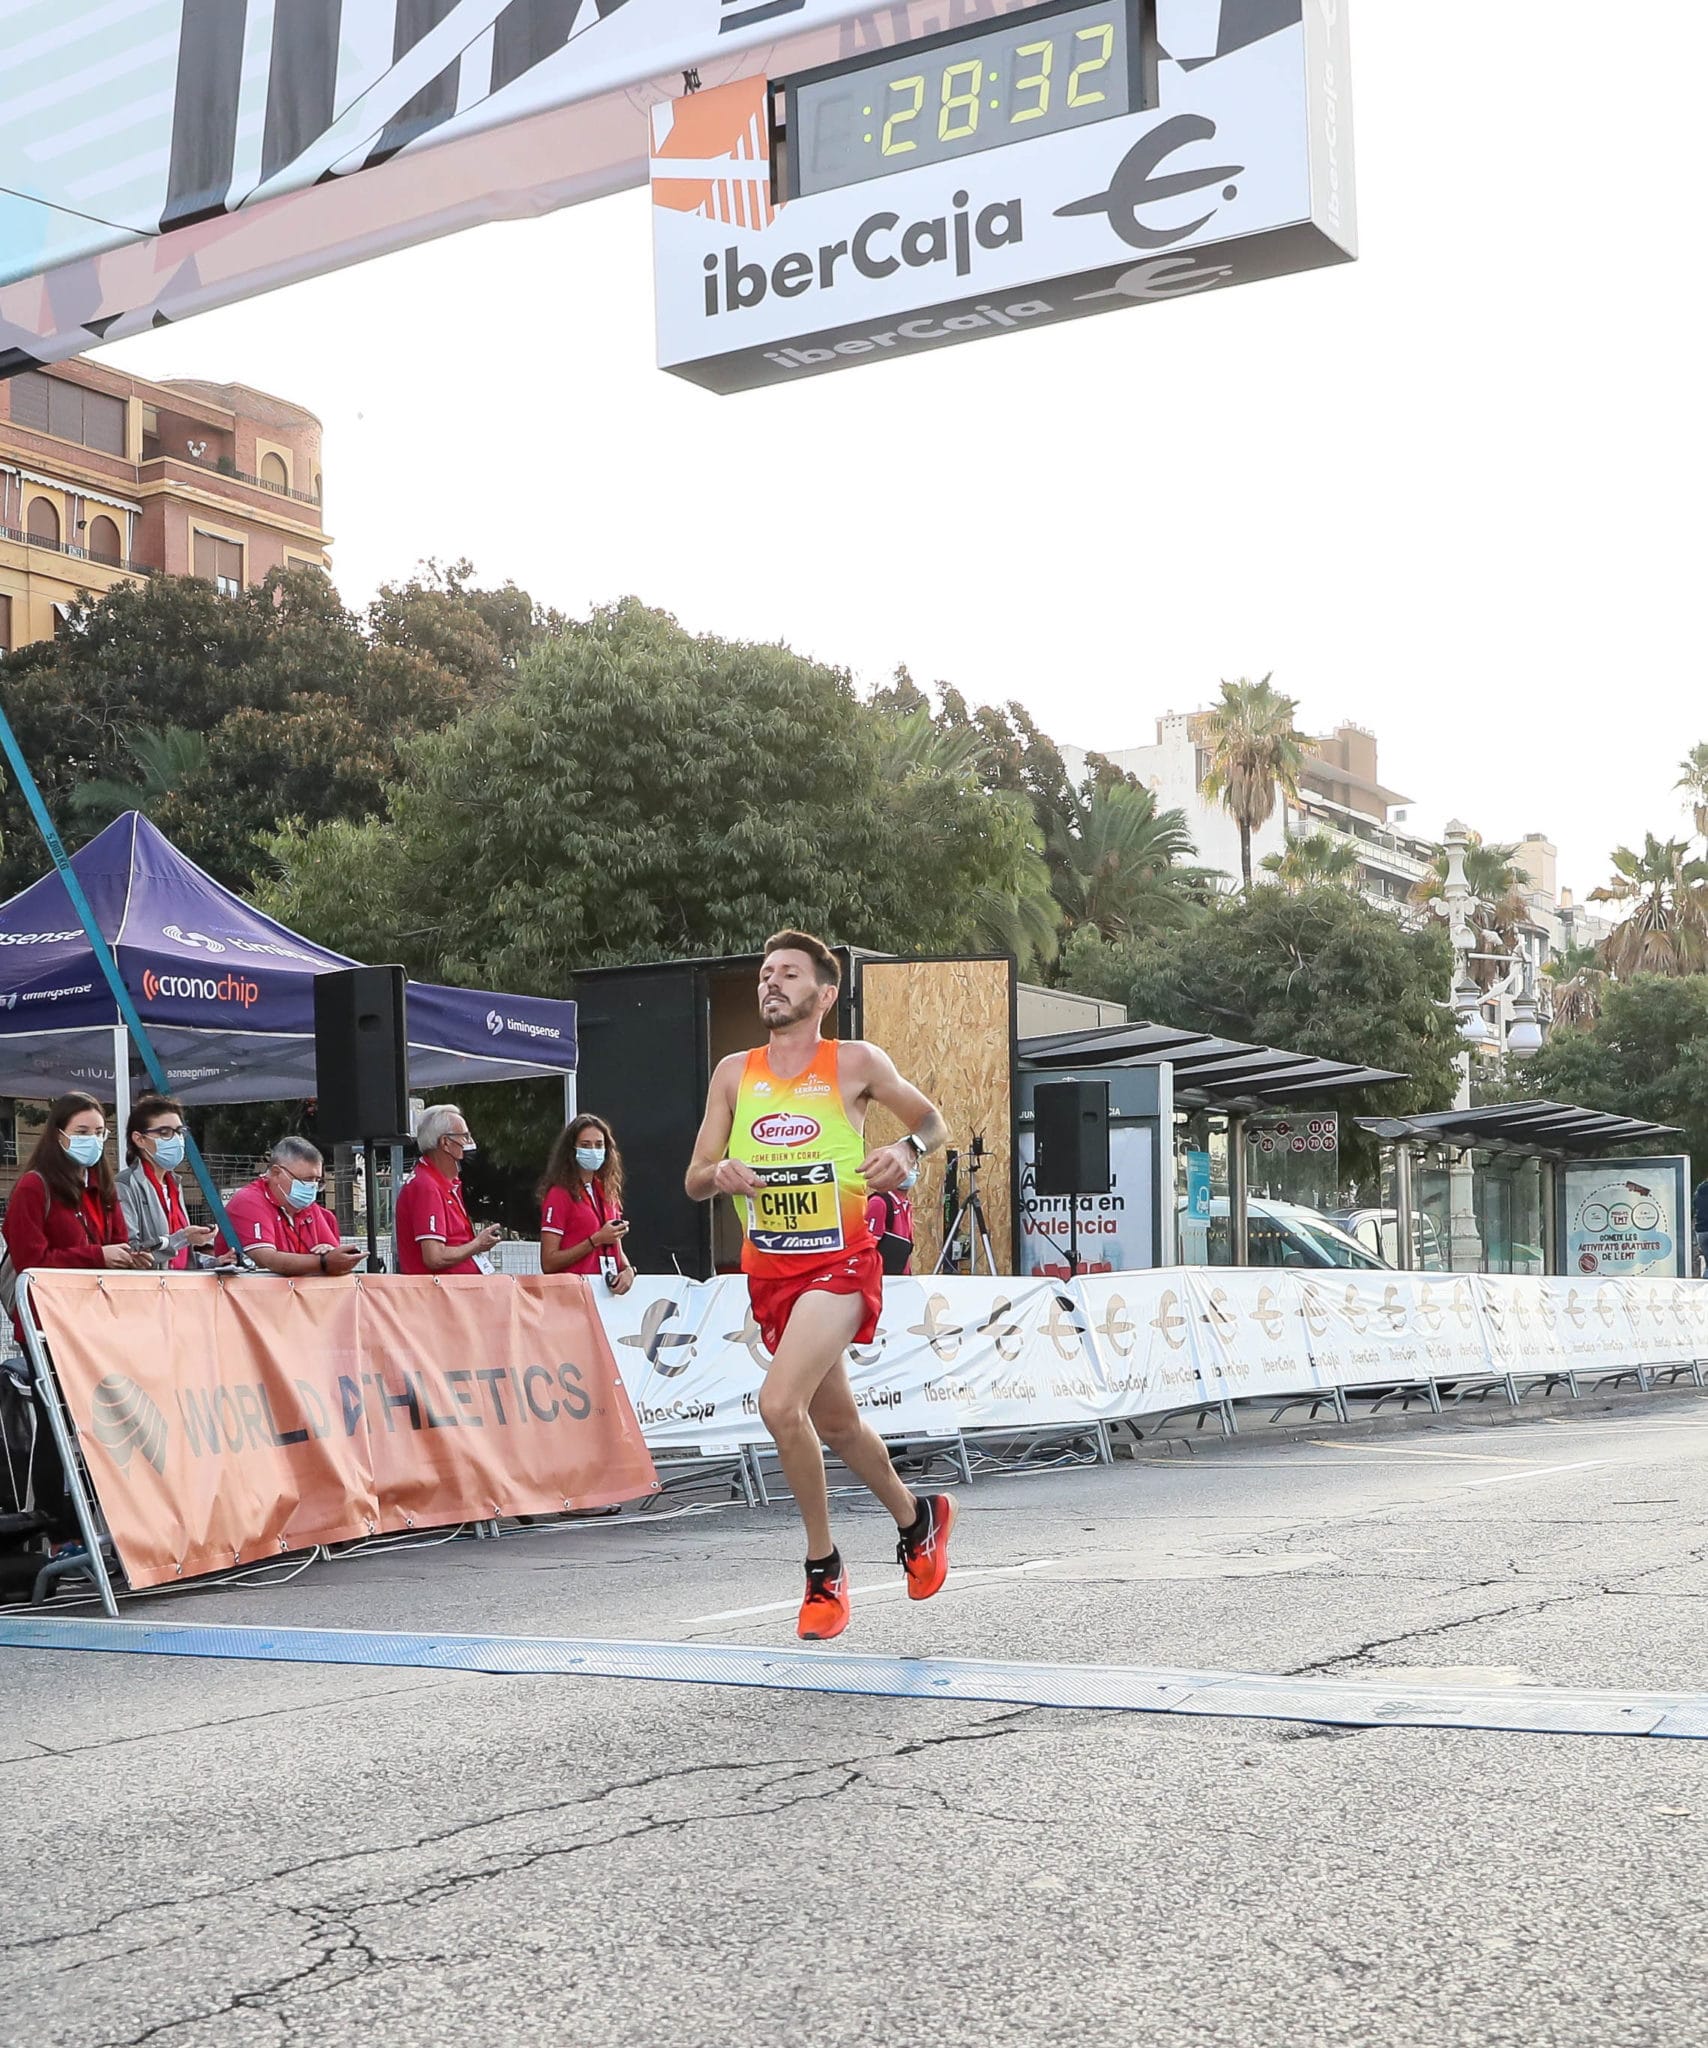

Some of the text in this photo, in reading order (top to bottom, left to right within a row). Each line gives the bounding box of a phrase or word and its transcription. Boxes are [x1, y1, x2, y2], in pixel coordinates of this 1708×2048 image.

[1323, 61, 1341, 228] iberCaja
[703, 189, 1024, 317] iberCaja
[763, 298, 1054, 371] iberCaja
[159, 973, 258, 1008] cronochip
[507, 1018, 560, 1038] timingsense
[757, 1122, 814, 1138] Serrano
[751, 1154, 769, 1163] COME
[771, 1152, 788, 1161] BIEN
[797, 1151, 820, 1160] CORRE
[752, 1170, 798, 1184] berCaja
[761, 1191, 818, 1216] CHIKI
[1098, 1196, 1125, 1211] en
[784, 1216, 798, 1230] 13
[1021, 1215, 1117, 1236] Valencia
[1625, 1233, 1638, 1241] LES
[854, 1385, 902, 1411] erCaja
[924, 1381, 976, 1406] iberCaja
[991, 1380, 1036, 1404] iberCaja
[175, 1376, 332, 1458] WORLD
[338, 1361, 592, 1437] ATHLETICS
[636, 1400, 716, 1424] iberCaja
